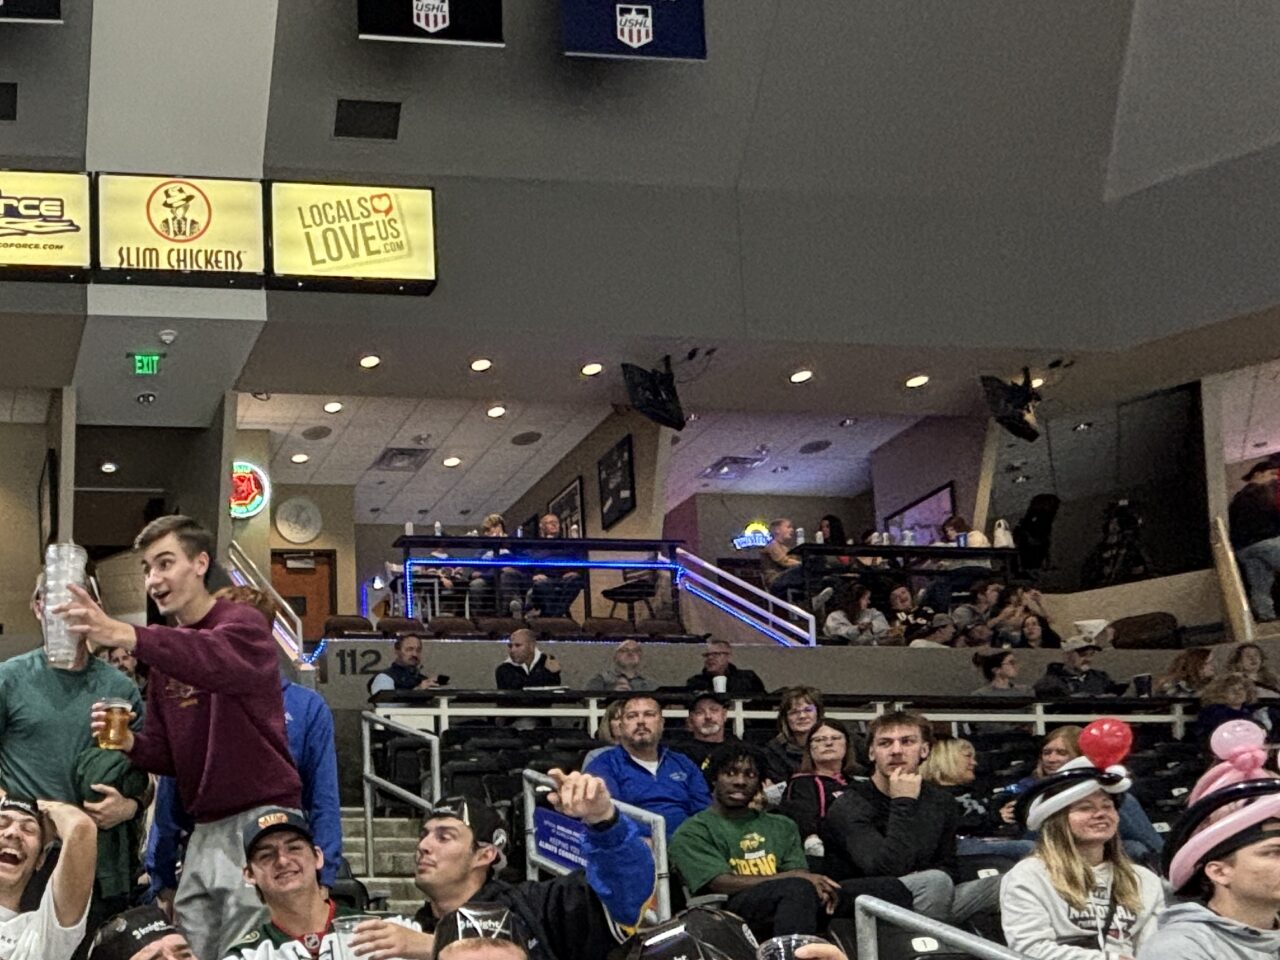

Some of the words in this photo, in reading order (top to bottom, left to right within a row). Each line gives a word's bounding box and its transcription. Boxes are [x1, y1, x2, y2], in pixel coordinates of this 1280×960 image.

[415, 2, 447, 13] USHL
[618, 17, 649, 28] USHL
[297, 196, 372, 229] LOCALS
[304, 221, 382, 266] LOVE
[376, 217, 401, 241] US
[118, 246, 160, 268] SLIM
[167, 248, 244, 270] CHICKENS
[134, 355, 160, 374] EXIT
[336, 648, 382, 675] 112
[140, 919, 167, 936] knight
